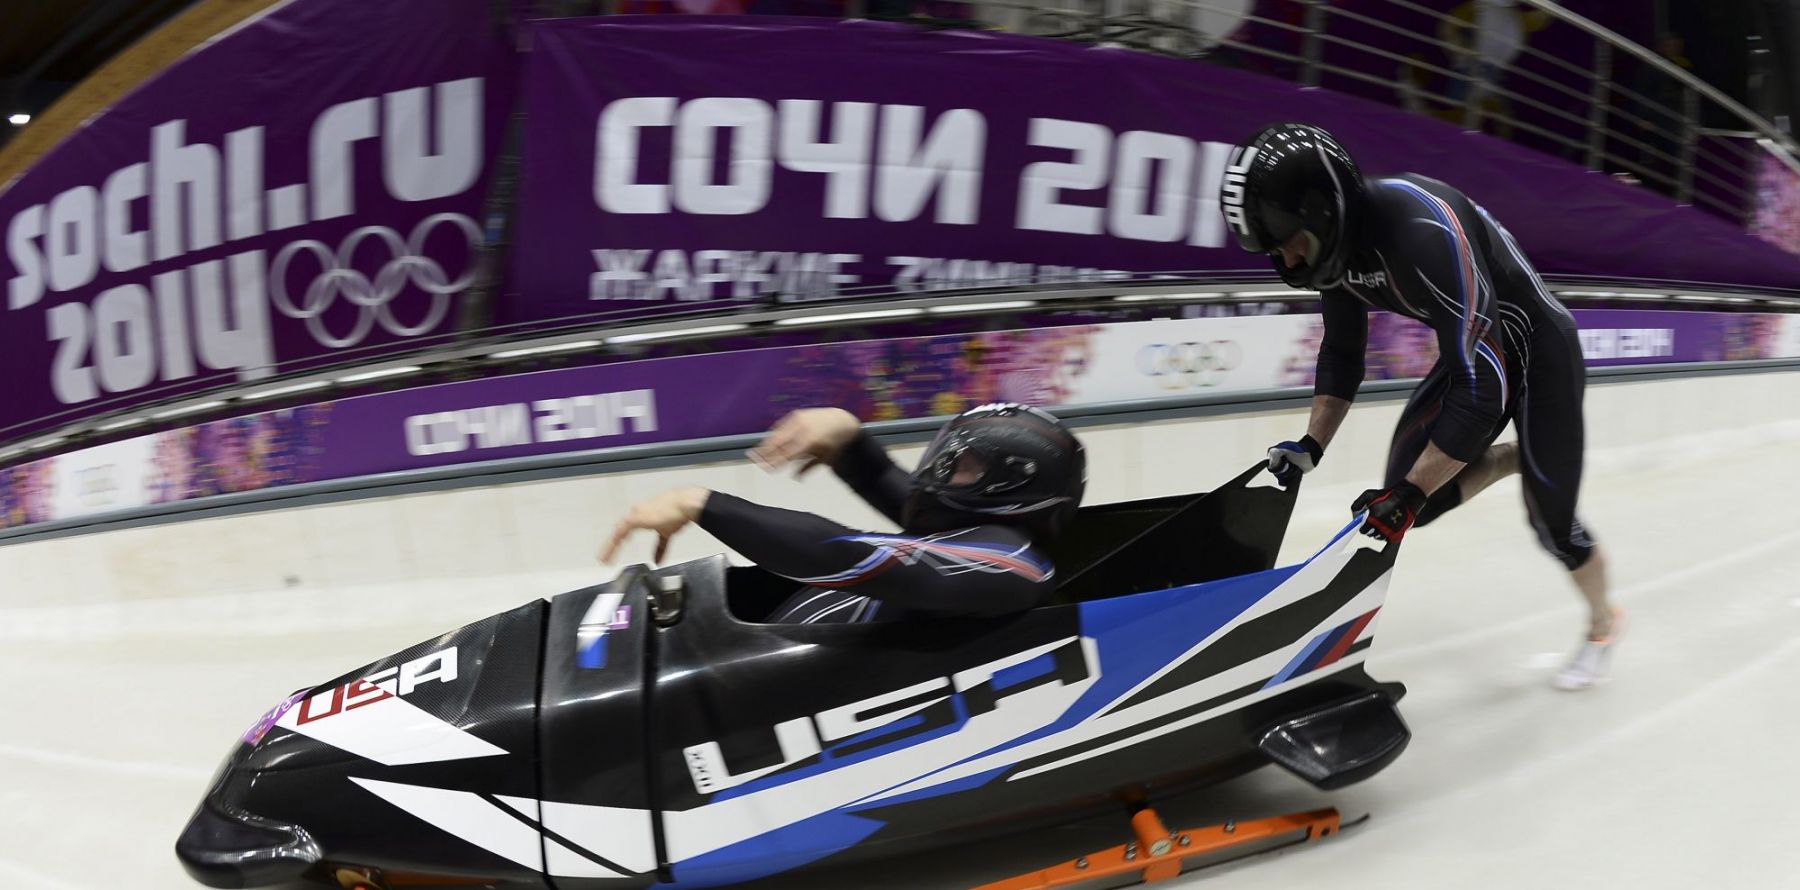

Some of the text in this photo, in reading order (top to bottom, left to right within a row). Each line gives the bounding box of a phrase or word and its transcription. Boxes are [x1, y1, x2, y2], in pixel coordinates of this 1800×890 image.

[7, 77, 485, 310] sochi.ru
[594, 97, 1236, 249] СОЧИ 201
[1222, 145, 1260, 236] USA
[1347, 269, 1387, 288] USA
[532, 388, 659, 443] 2014
[296, 646, 458, 726] USA
[683, 635, 1090, 794] USA
